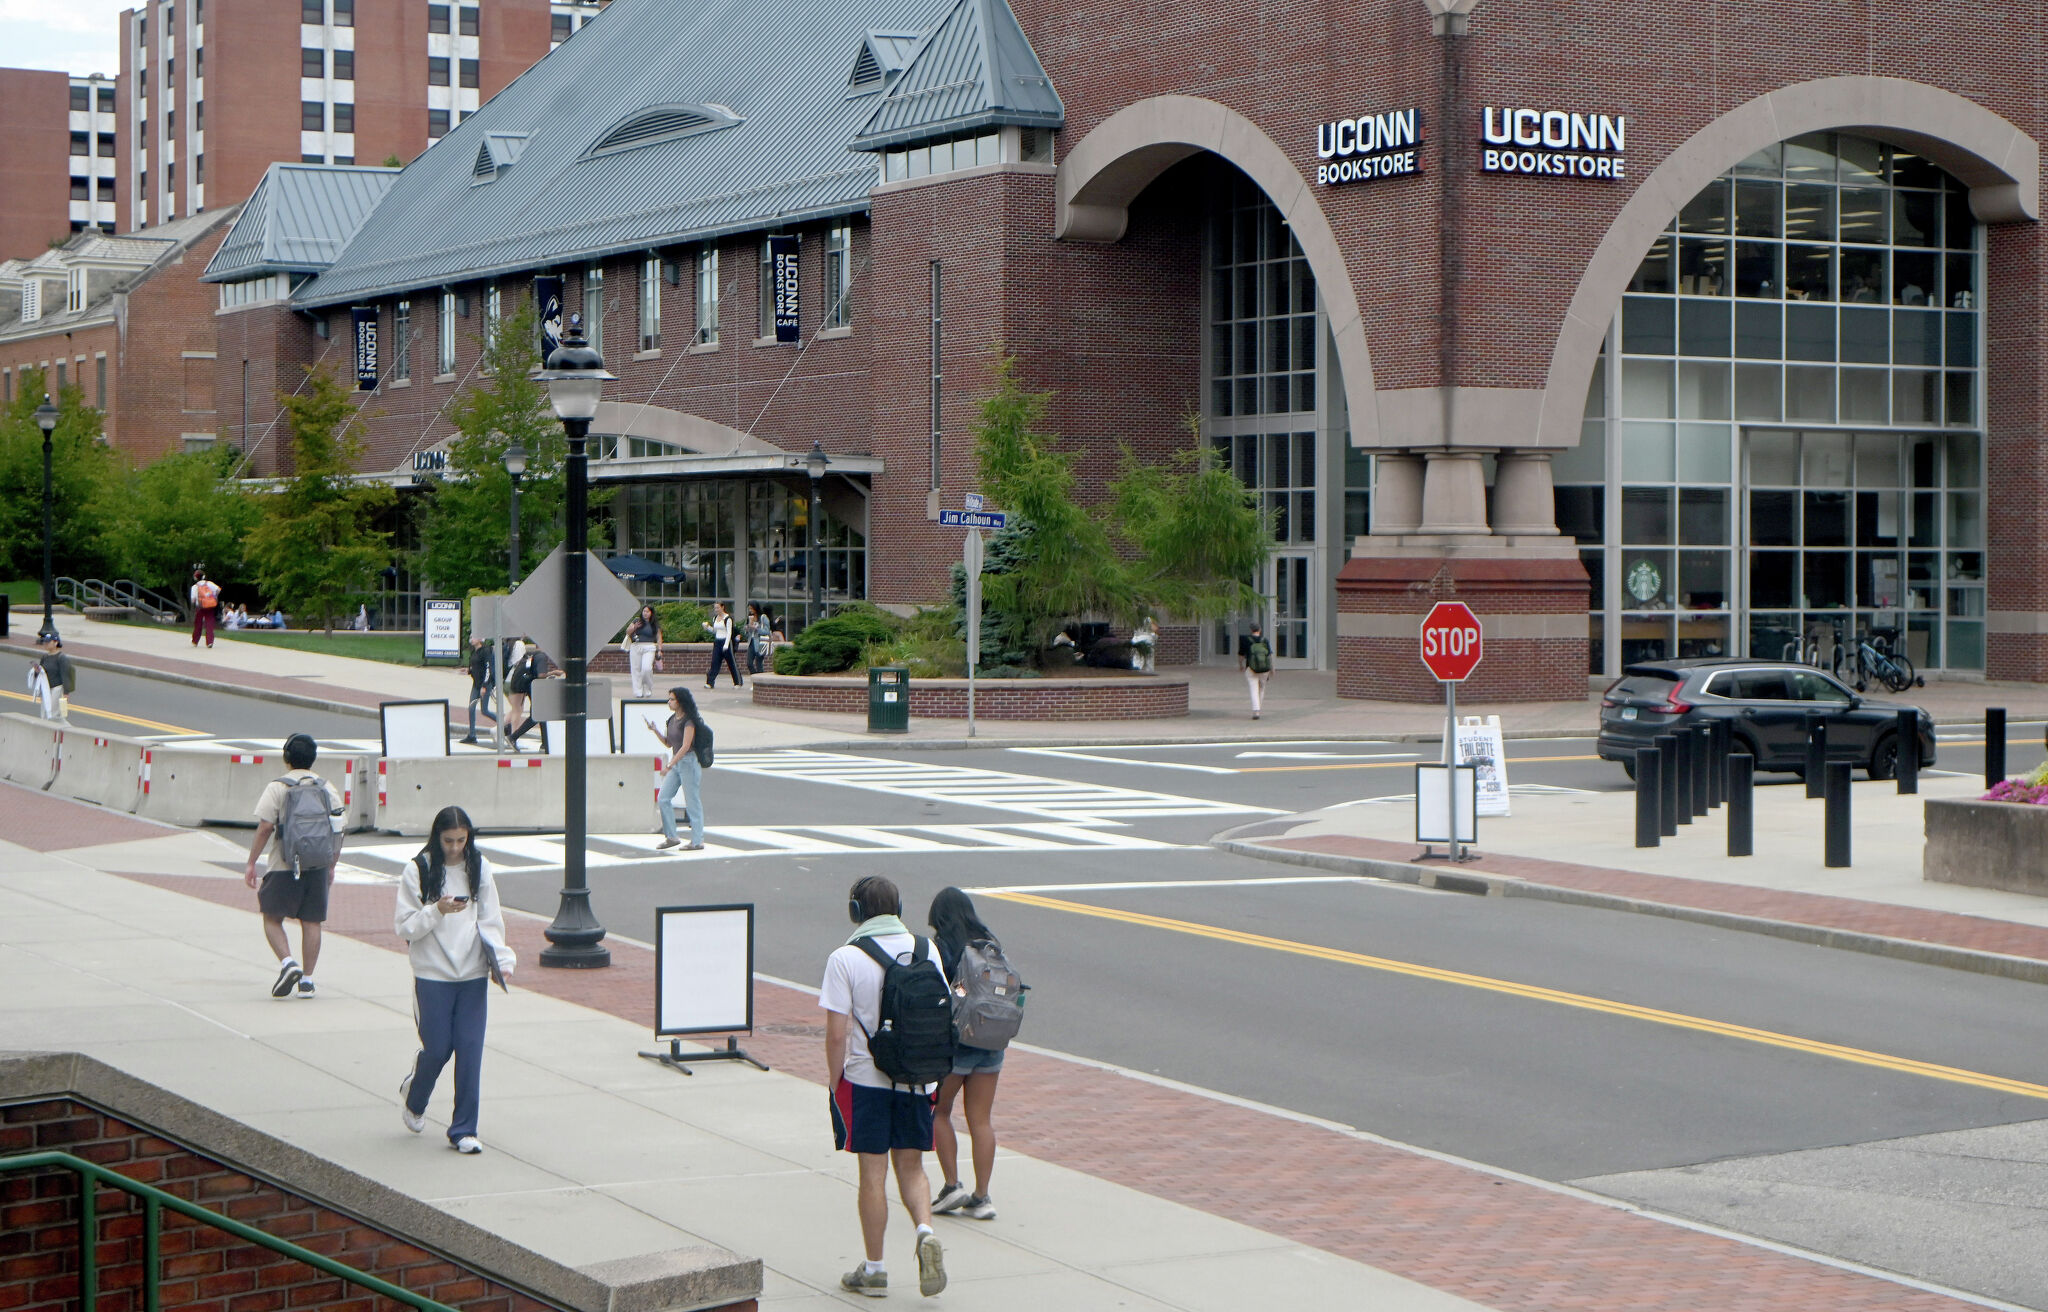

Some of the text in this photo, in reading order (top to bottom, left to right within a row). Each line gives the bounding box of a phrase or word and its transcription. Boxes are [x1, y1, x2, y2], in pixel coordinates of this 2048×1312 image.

[1318, 108, 1416, 159] UCONN
[1483, 106, 1625, 151] UCONN
[1318, 151, 1415, 185] BOOKSTORE
[1484, 149, 1625, 178] BOOKSTORE
[776, 253, 784, 315] BOOKSTORE
[785, 254, 798, 316] UCONN
[358, 321, 366, 370] BOOKSTORE
[366, 322, 377, 370] UCONN
[943, 511, 959, 524] Jim
[960, 512, 991, 526] Calhoun
[1425, 627, 1478, 656] STOP
[1459, 736, 1493, 744] STUDENT
[1460, 742, 1495, 757] TAILGATE
